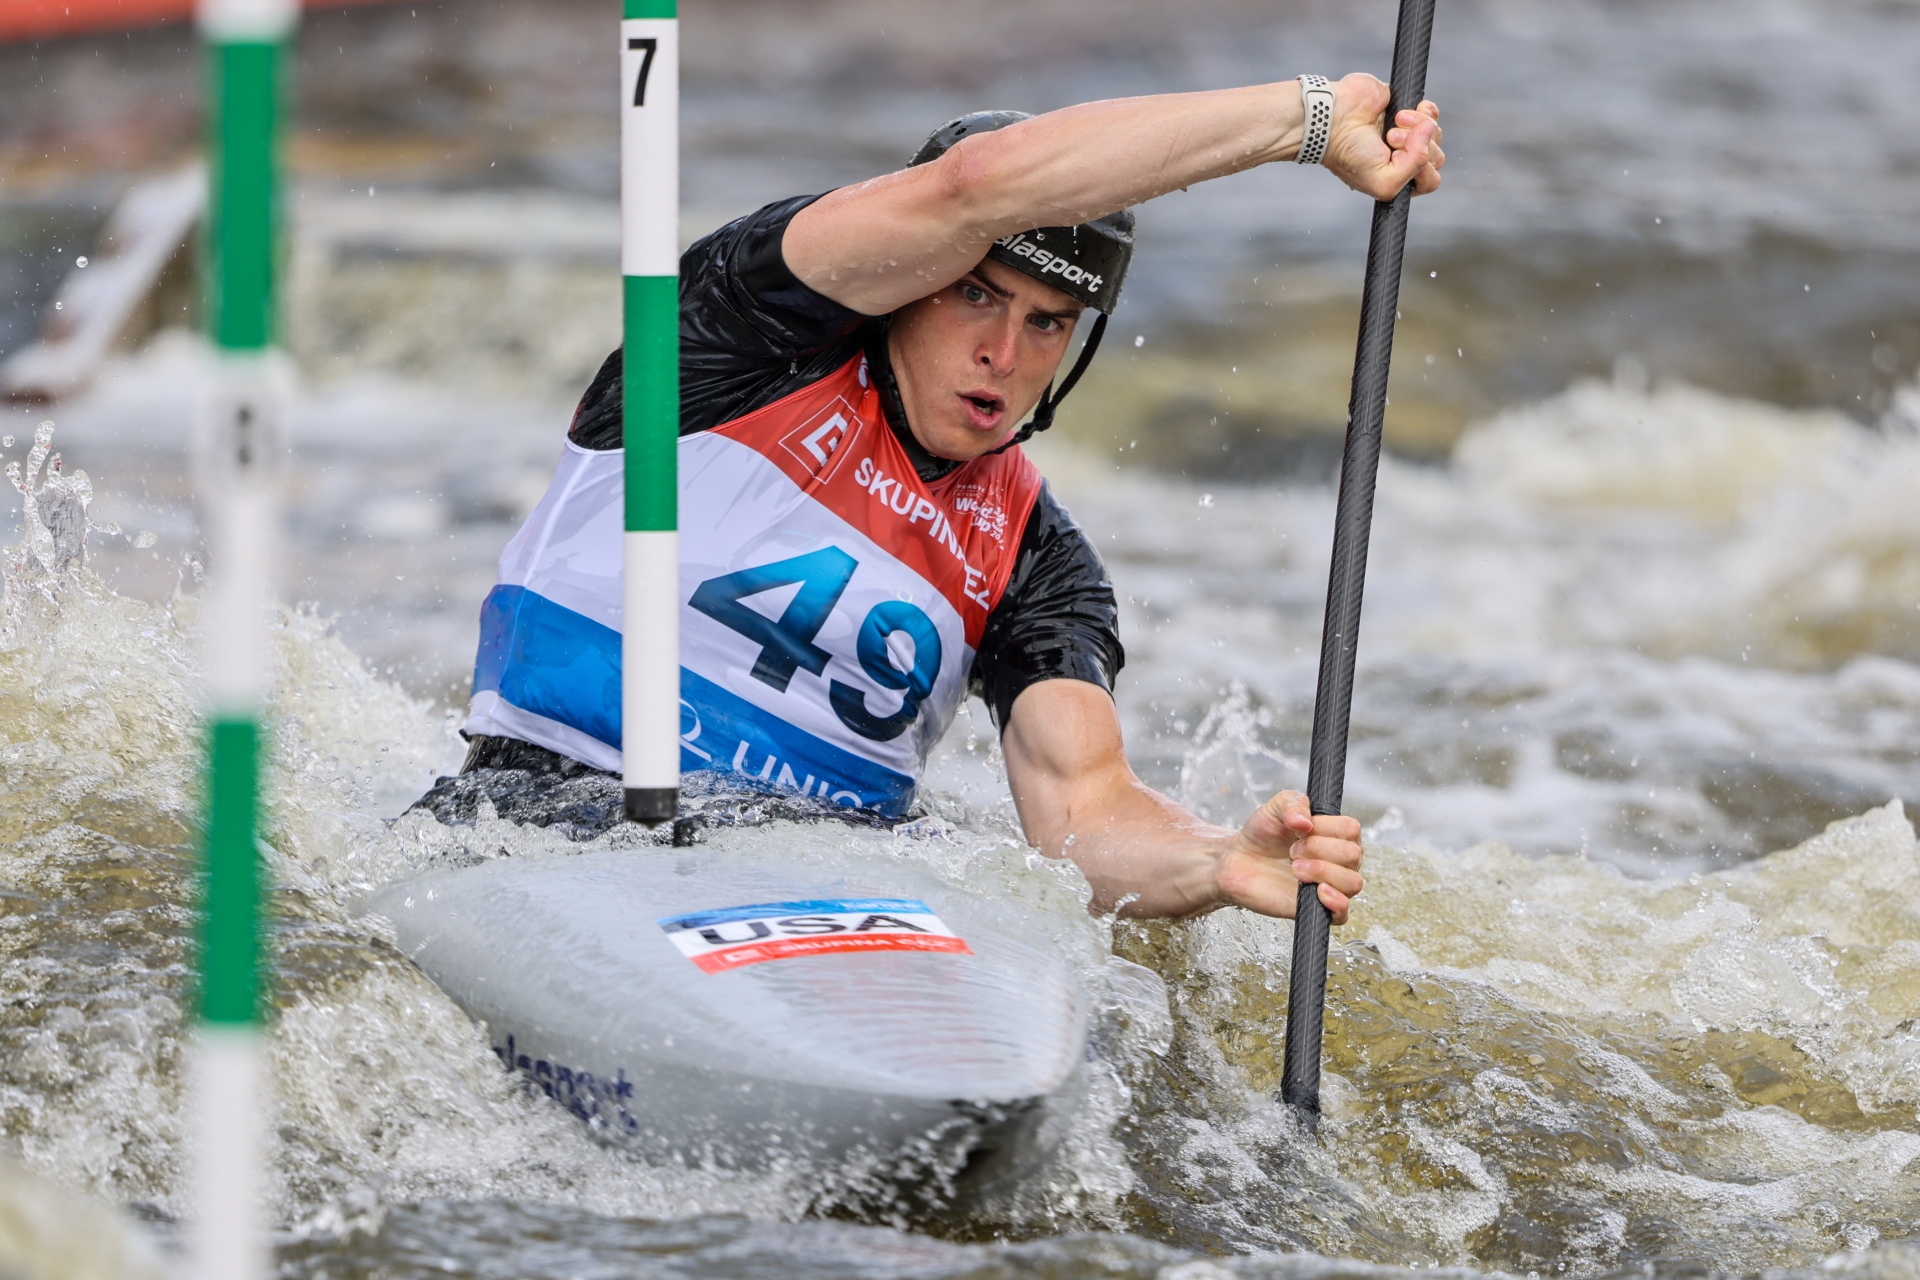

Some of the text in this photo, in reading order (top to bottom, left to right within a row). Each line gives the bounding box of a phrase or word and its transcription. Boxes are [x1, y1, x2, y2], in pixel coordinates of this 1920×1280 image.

[628, 38, 657, 107] 7
[993, 233, 1104, 293] alasport
[687, 545, 942, 742] 49
[699, 914, 935, 945] USA
